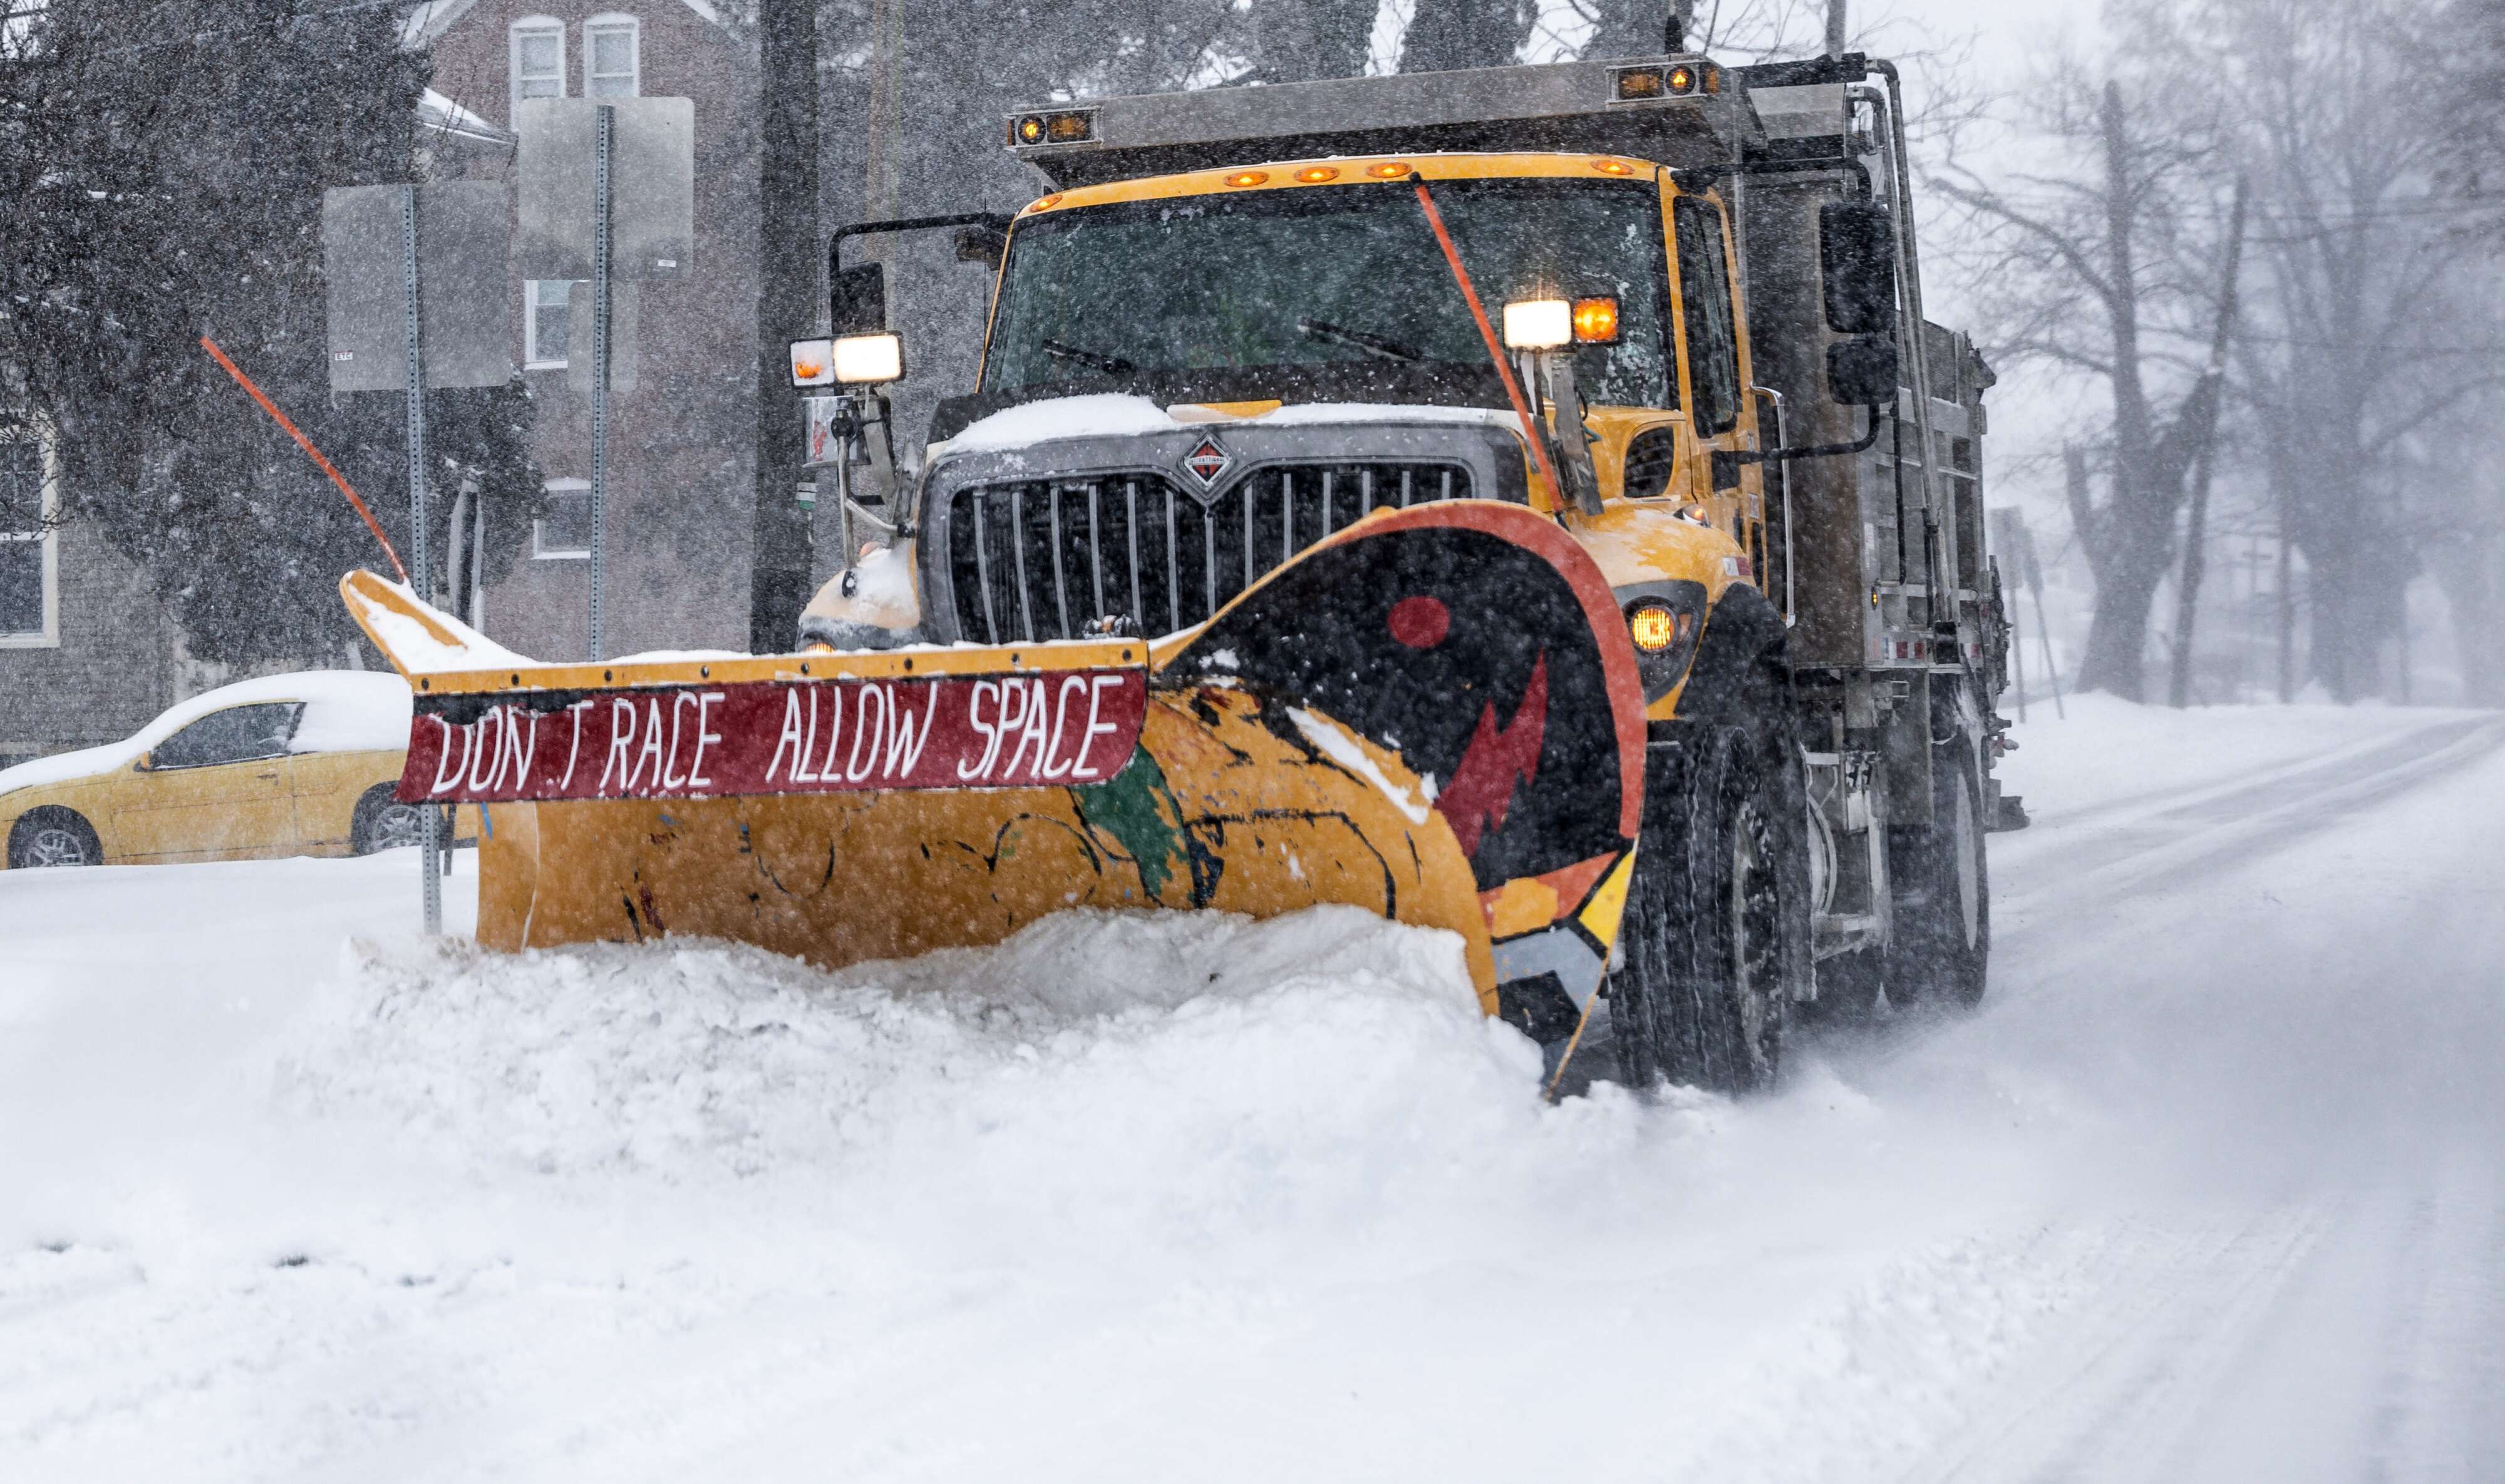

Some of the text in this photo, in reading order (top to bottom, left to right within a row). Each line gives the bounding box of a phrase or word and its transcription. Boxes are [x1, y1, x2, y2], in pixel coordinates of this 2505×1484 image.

[599, 691, 725, 790] RACE
[765, 681, 938, 783] ALLOW
[958, 676, 1125, 780] SPACE
